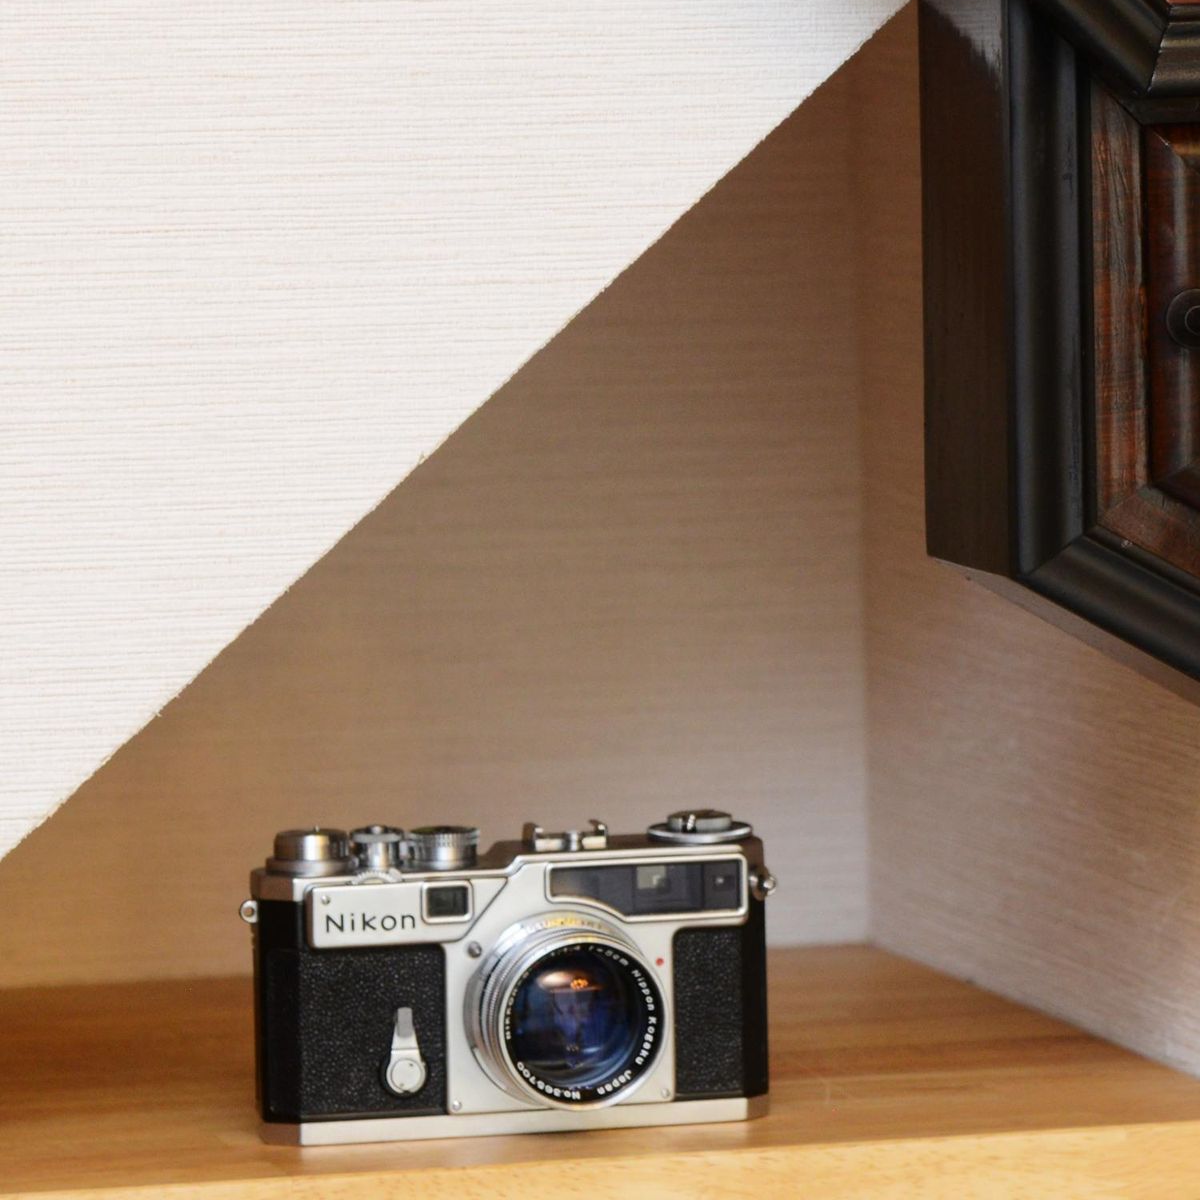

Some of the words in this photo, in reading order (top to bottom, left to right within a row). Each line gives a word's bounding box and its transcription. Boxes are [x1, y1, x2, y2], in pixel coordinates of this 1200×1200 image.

[326, 912, 416, 934] Nikon
[631, 969, 656, 1012] Nippon
[634, 1016, 658, 1066] Kogaku
[596, 1069, 634, 1096] Japan
